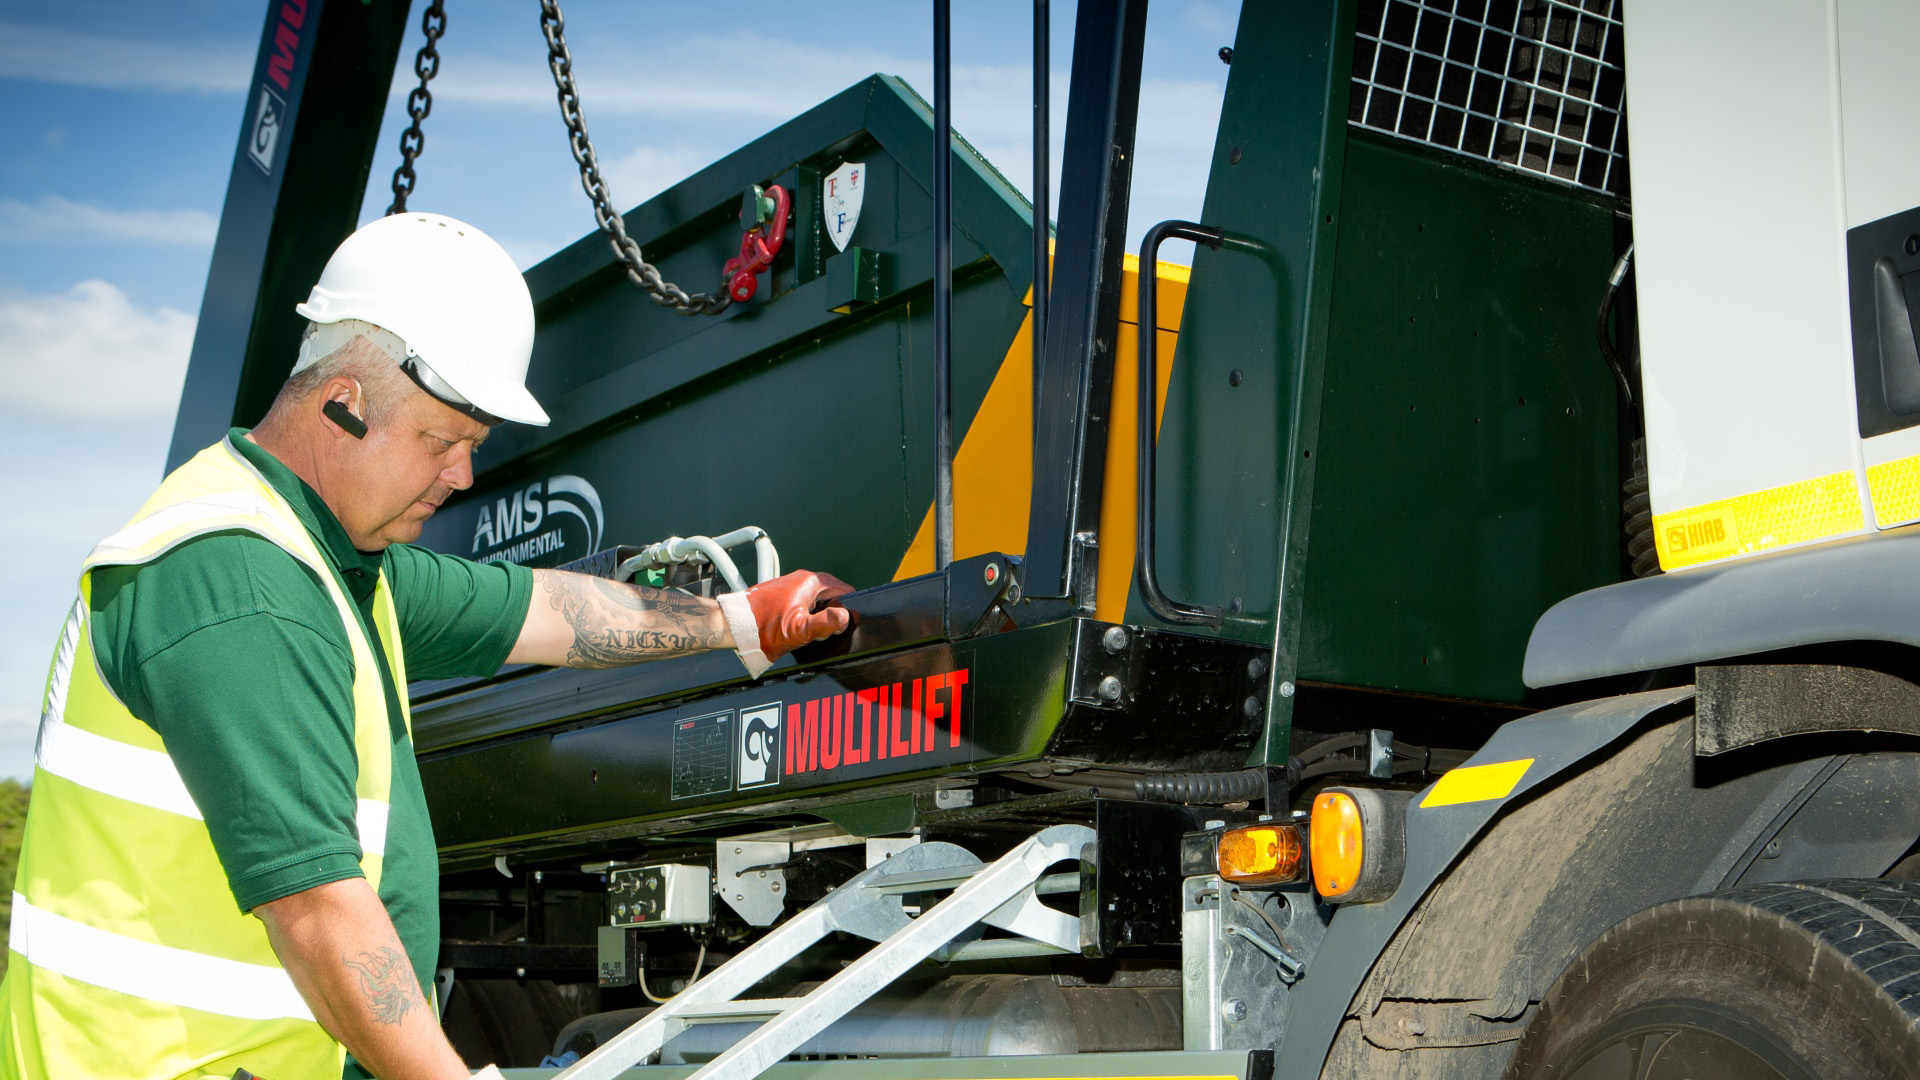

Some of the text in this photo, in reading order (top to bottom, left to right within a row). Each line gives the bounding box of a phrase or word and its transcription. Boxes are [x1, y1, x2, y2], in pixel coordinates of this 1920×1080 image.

[472, 482, 543, 553] AMS
[1687, 518, 1726, 548] HIAB
[475, 528, 565, 564] ONMENTAL
[785, 668, 969, 775] MULTILIFT
